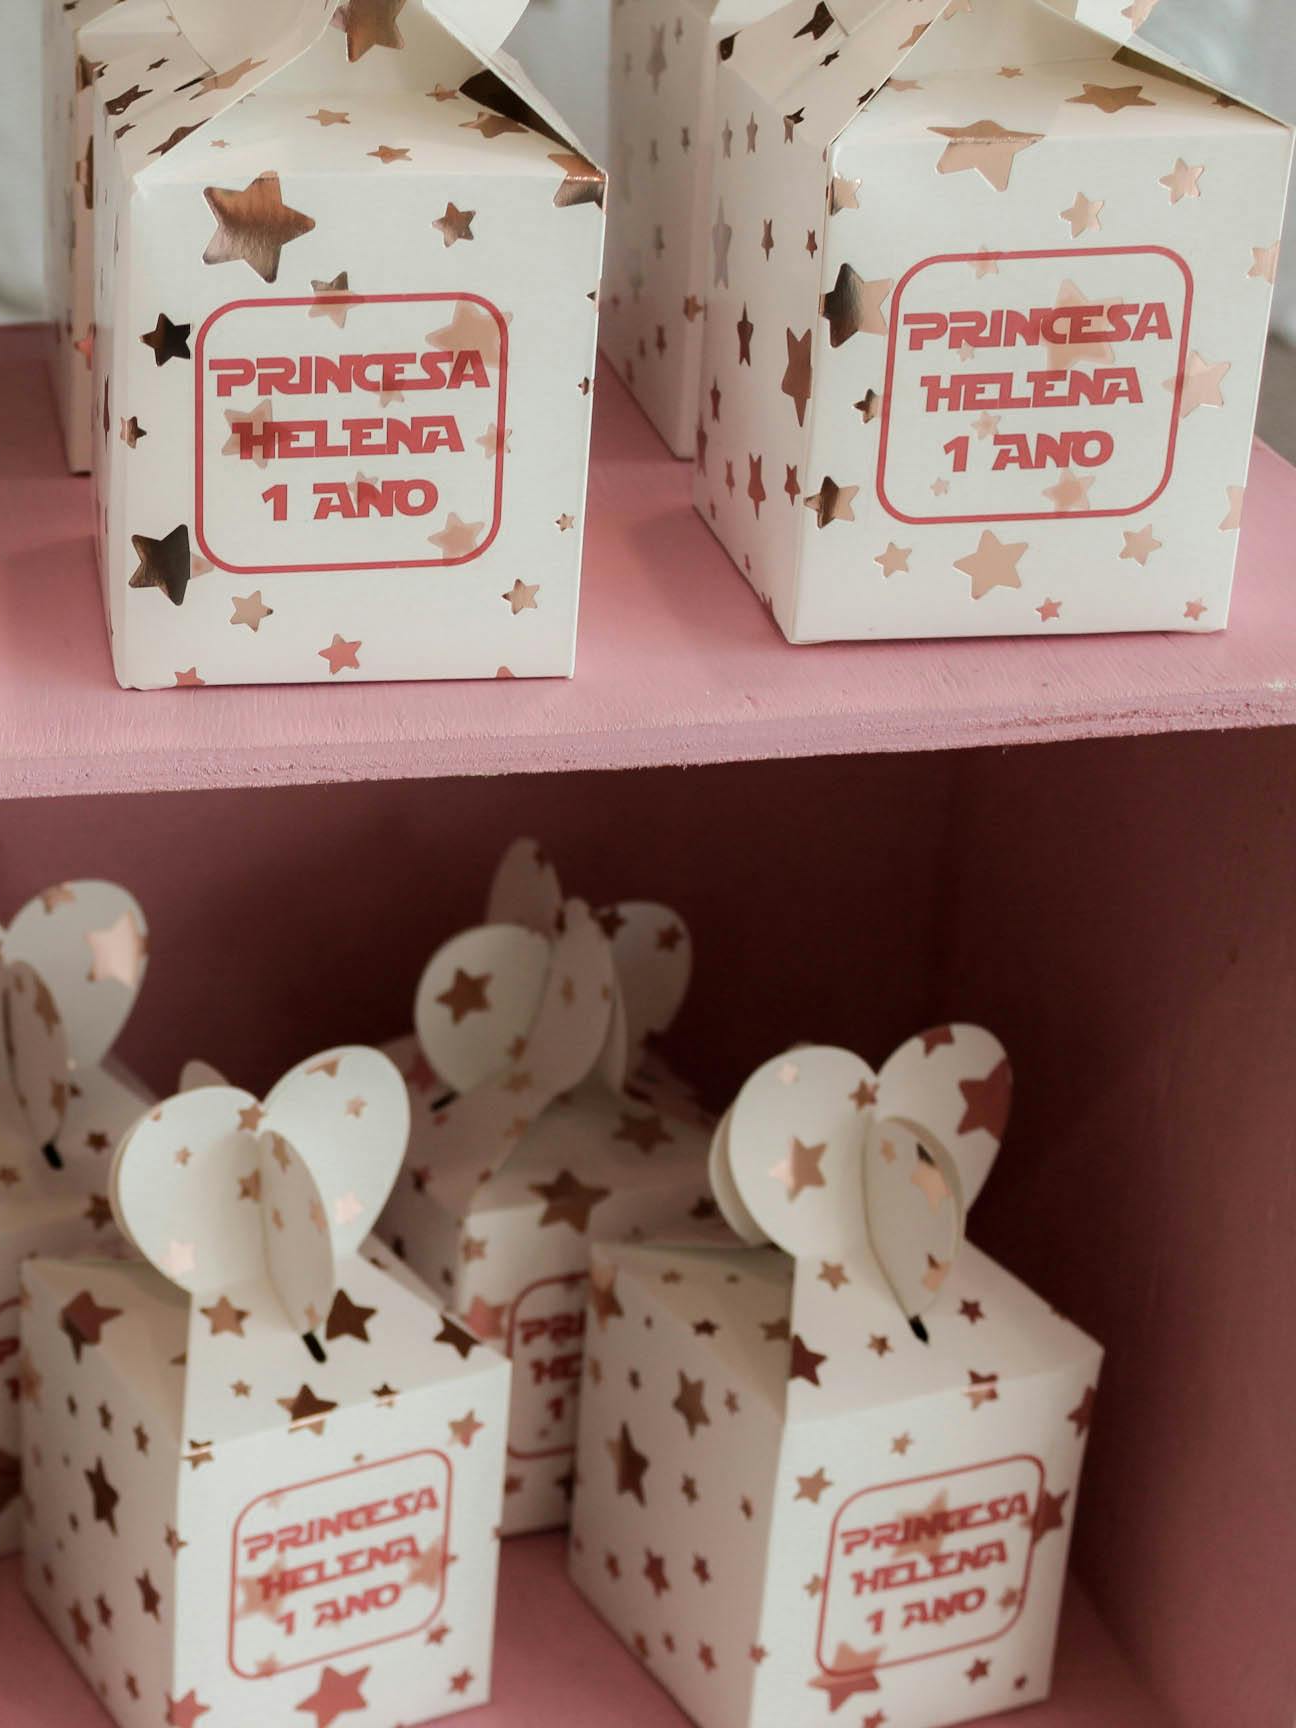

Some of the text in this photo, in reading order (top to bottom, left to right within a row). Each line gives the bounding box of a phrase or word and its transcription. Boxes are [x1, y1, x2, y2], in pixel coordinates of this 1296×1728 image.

[903, 302, 1173, 351] PRINCESA
[209, 350, 491, 397] PRINCESA
[920, 367, 1144, 412] HELENA
[232, 415, 465, 460] HELENA
[943, 430, 1114, 472] 1 ANO
[262, 479, 439, 521] 1 ANO
[242, 1486, 439, 1562] PRINCESA
[840, 1491, 1029, 1556] PRINCESA
[256, 1535, 421, 1602] HELENA
[850, 1540, 1008, 1596] HELENA
[275, 1583, 402, 1636] 1 ANO
[866, 1587, 988, 1635] 1 ANO
